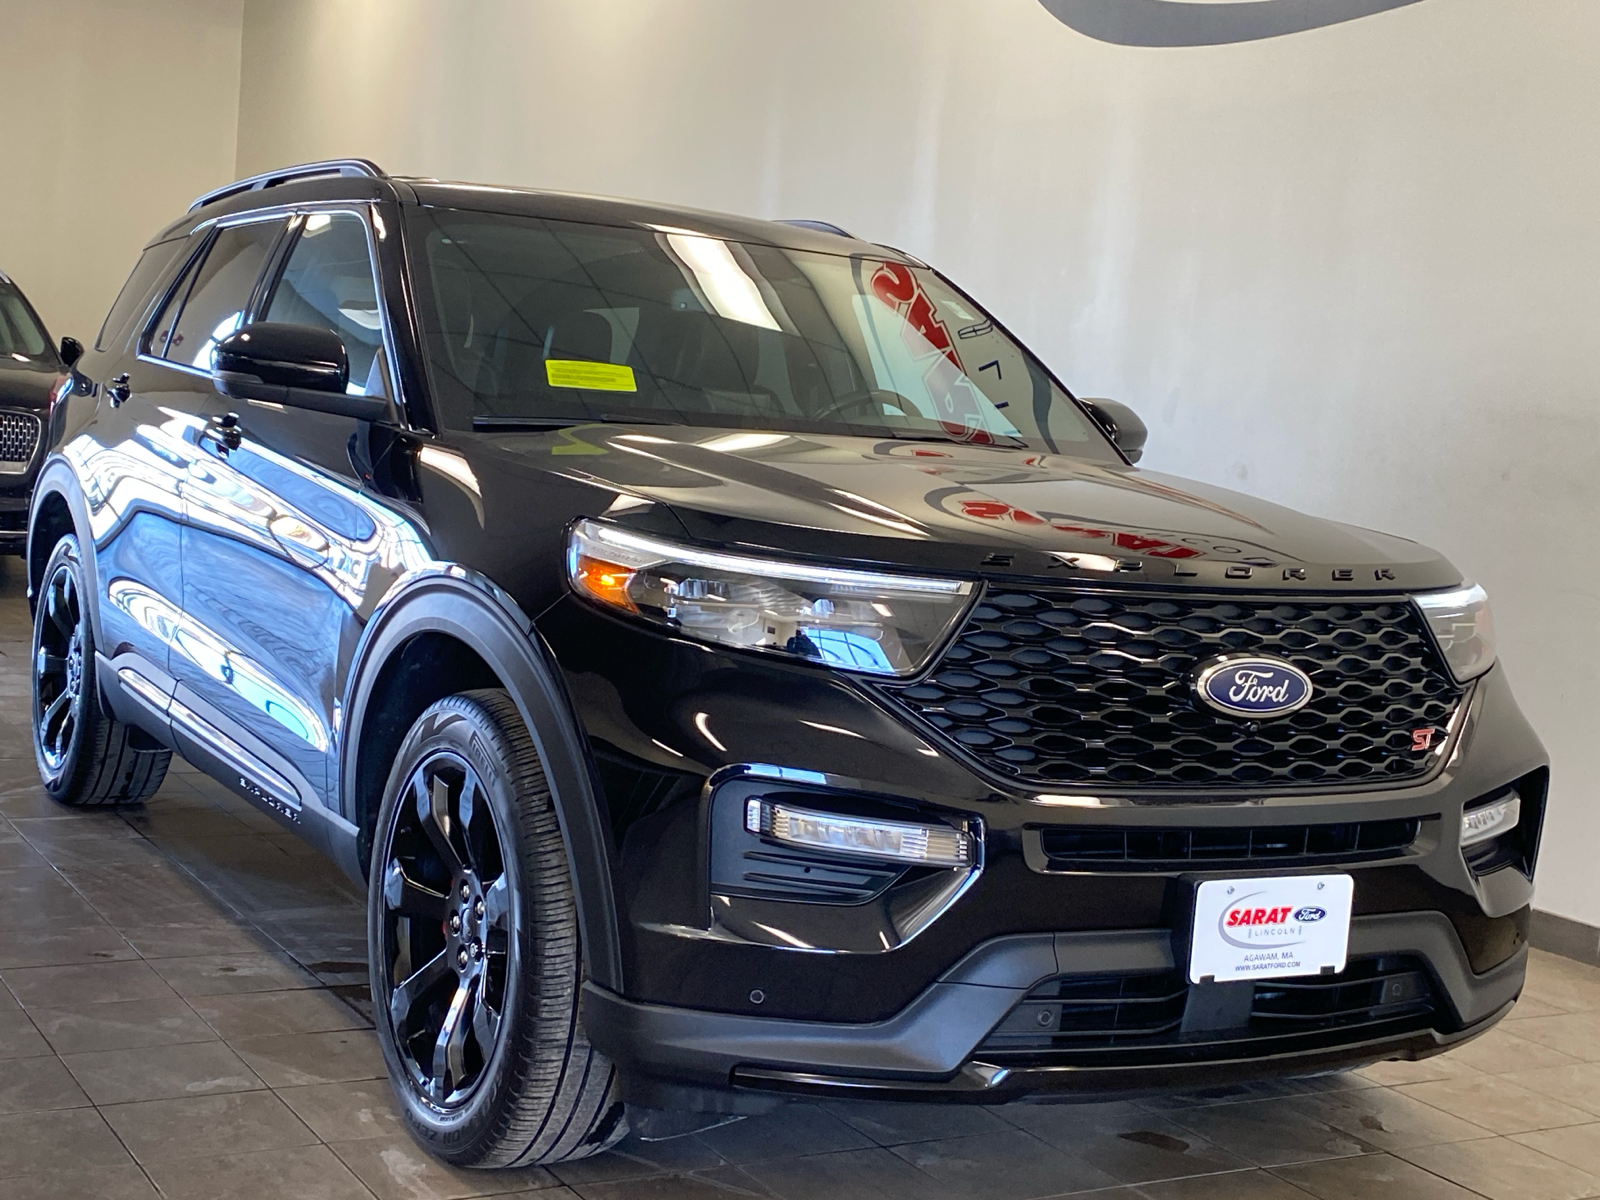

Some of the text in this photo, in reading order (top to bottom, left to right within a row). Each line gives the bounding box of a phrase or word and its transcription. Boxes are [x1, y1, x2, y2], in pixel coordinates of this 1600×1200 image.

[981, 552, 1397, 581] EXPLORER
[1229, 670, 1289, 702] Ford
[1412, 728, 1436, 751] ST
[1226, 906, 1293, 928] SARAT
[1254, 928, 1296, 937] LINCOLN
[1234, 961, 1301, 972] WWW.SARATFORD.COM
[1243, 951, 1294, 962] AGAWAM, MA
